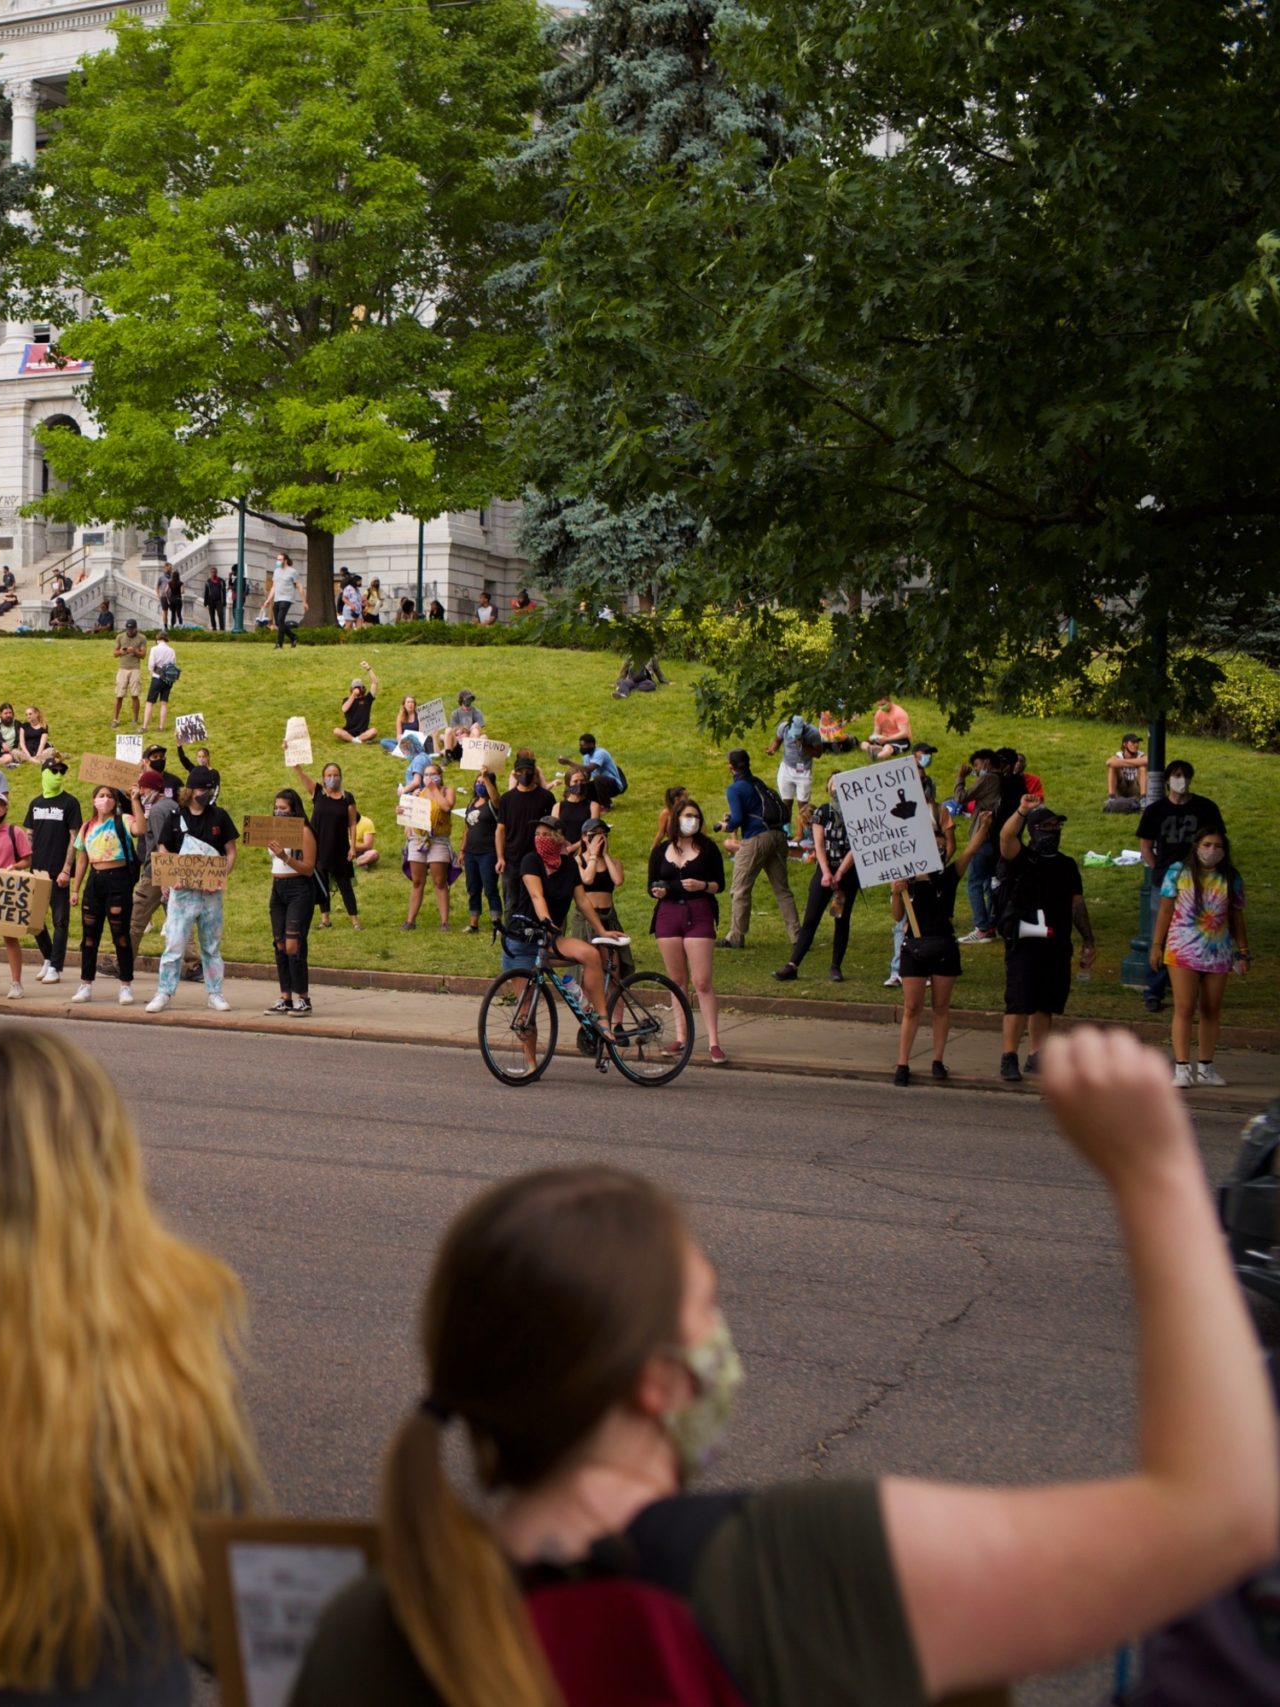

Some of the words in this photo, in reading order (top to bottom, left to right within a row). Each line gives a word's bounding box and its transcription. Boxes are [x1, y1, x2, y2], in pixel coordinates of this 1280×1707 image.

[117, 735, 141, 746] JUSTICE
[91, 757, 104, 770] NO
[85, 769, 97, 780] NO
[840, 766, 915, 801] RACISM
[867, 793, 887, 812] IS
[852, 825, 910, 852] COOCHIE
[1161, 815, 1199, 844] 42
[177, 855, 205, 868] COPS
[861, 839, 917, 867] ENERGY
[154, 868, 161, 877] IS
[168, 867, 206, 878] GROOVY
[207, 869, 227, 878] MAN
[878, 861, 917, 881] #BLM
